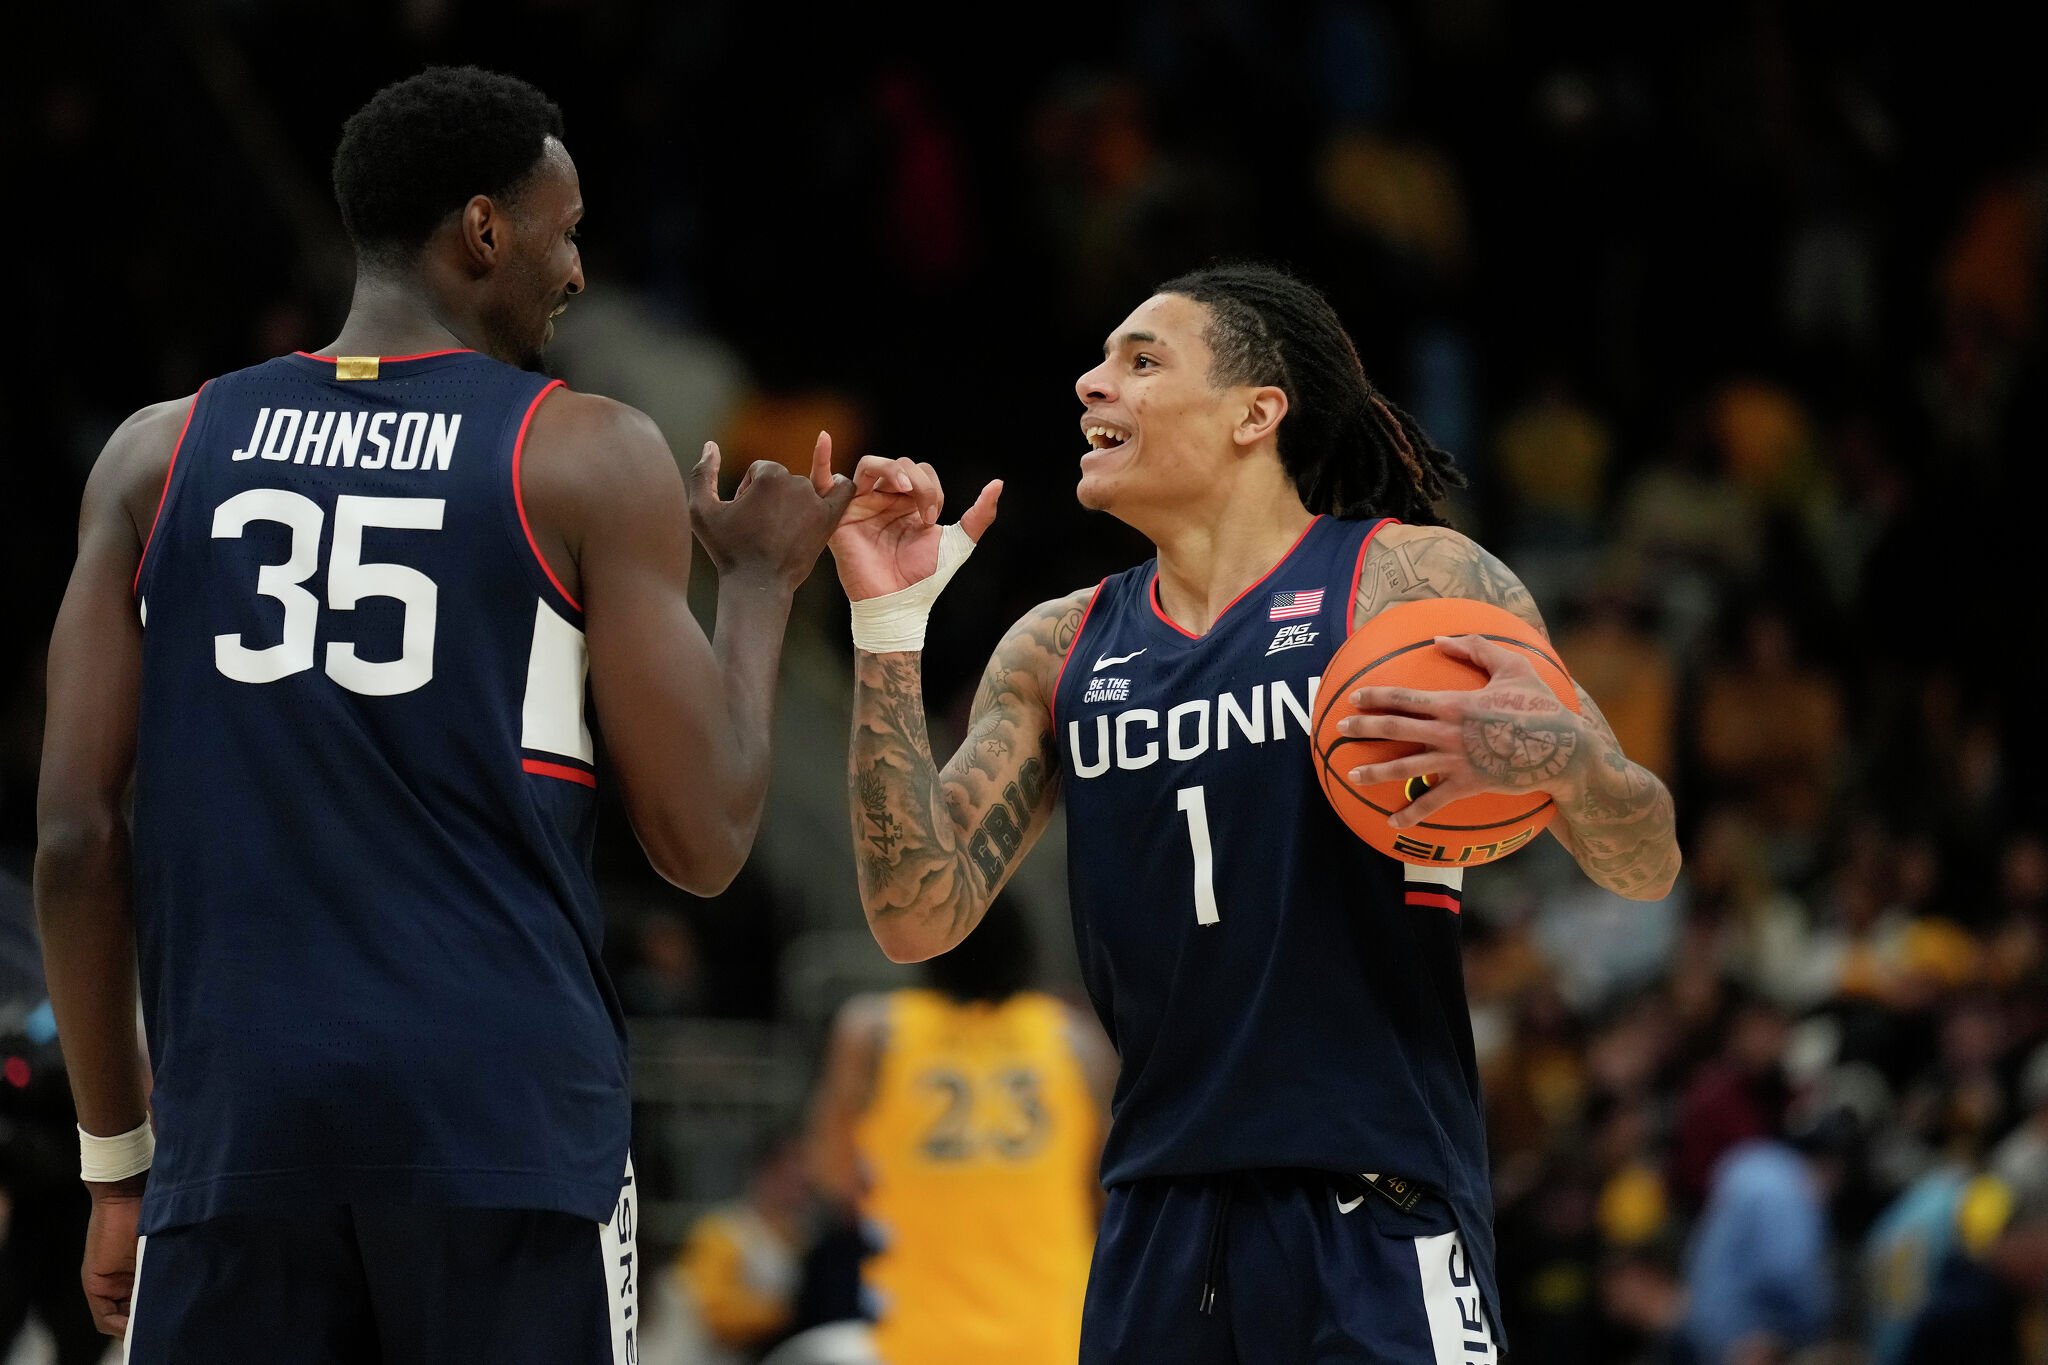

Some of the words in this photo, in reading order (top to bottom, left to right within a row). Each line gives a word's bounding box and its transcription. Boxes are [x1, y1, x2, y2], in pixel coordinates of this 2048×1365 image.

[231, 407, 462, 471] JOHNSON
[211, 488, 446, 696] 35
[1268, 632, 1319, 650] EAST
[1274, 622, 1312, 638] BIG
[1083, 689, 1130, 703] CHANGE
[1088, 677, 1106, 690] BE
[1106, 677, 1131, 689] THE
[1068, 676, 1321, 779] UCONN
[865, 811, 895, 855] 44
[1177, 785, 1220, 925] 1
[1393, 825, 1535, 863] ELITE
[915, 1064, 1055, 1159] 23
[1386, 1176, 1407, 1194] 46
[617, 1176, 639, 1365] SKIE
